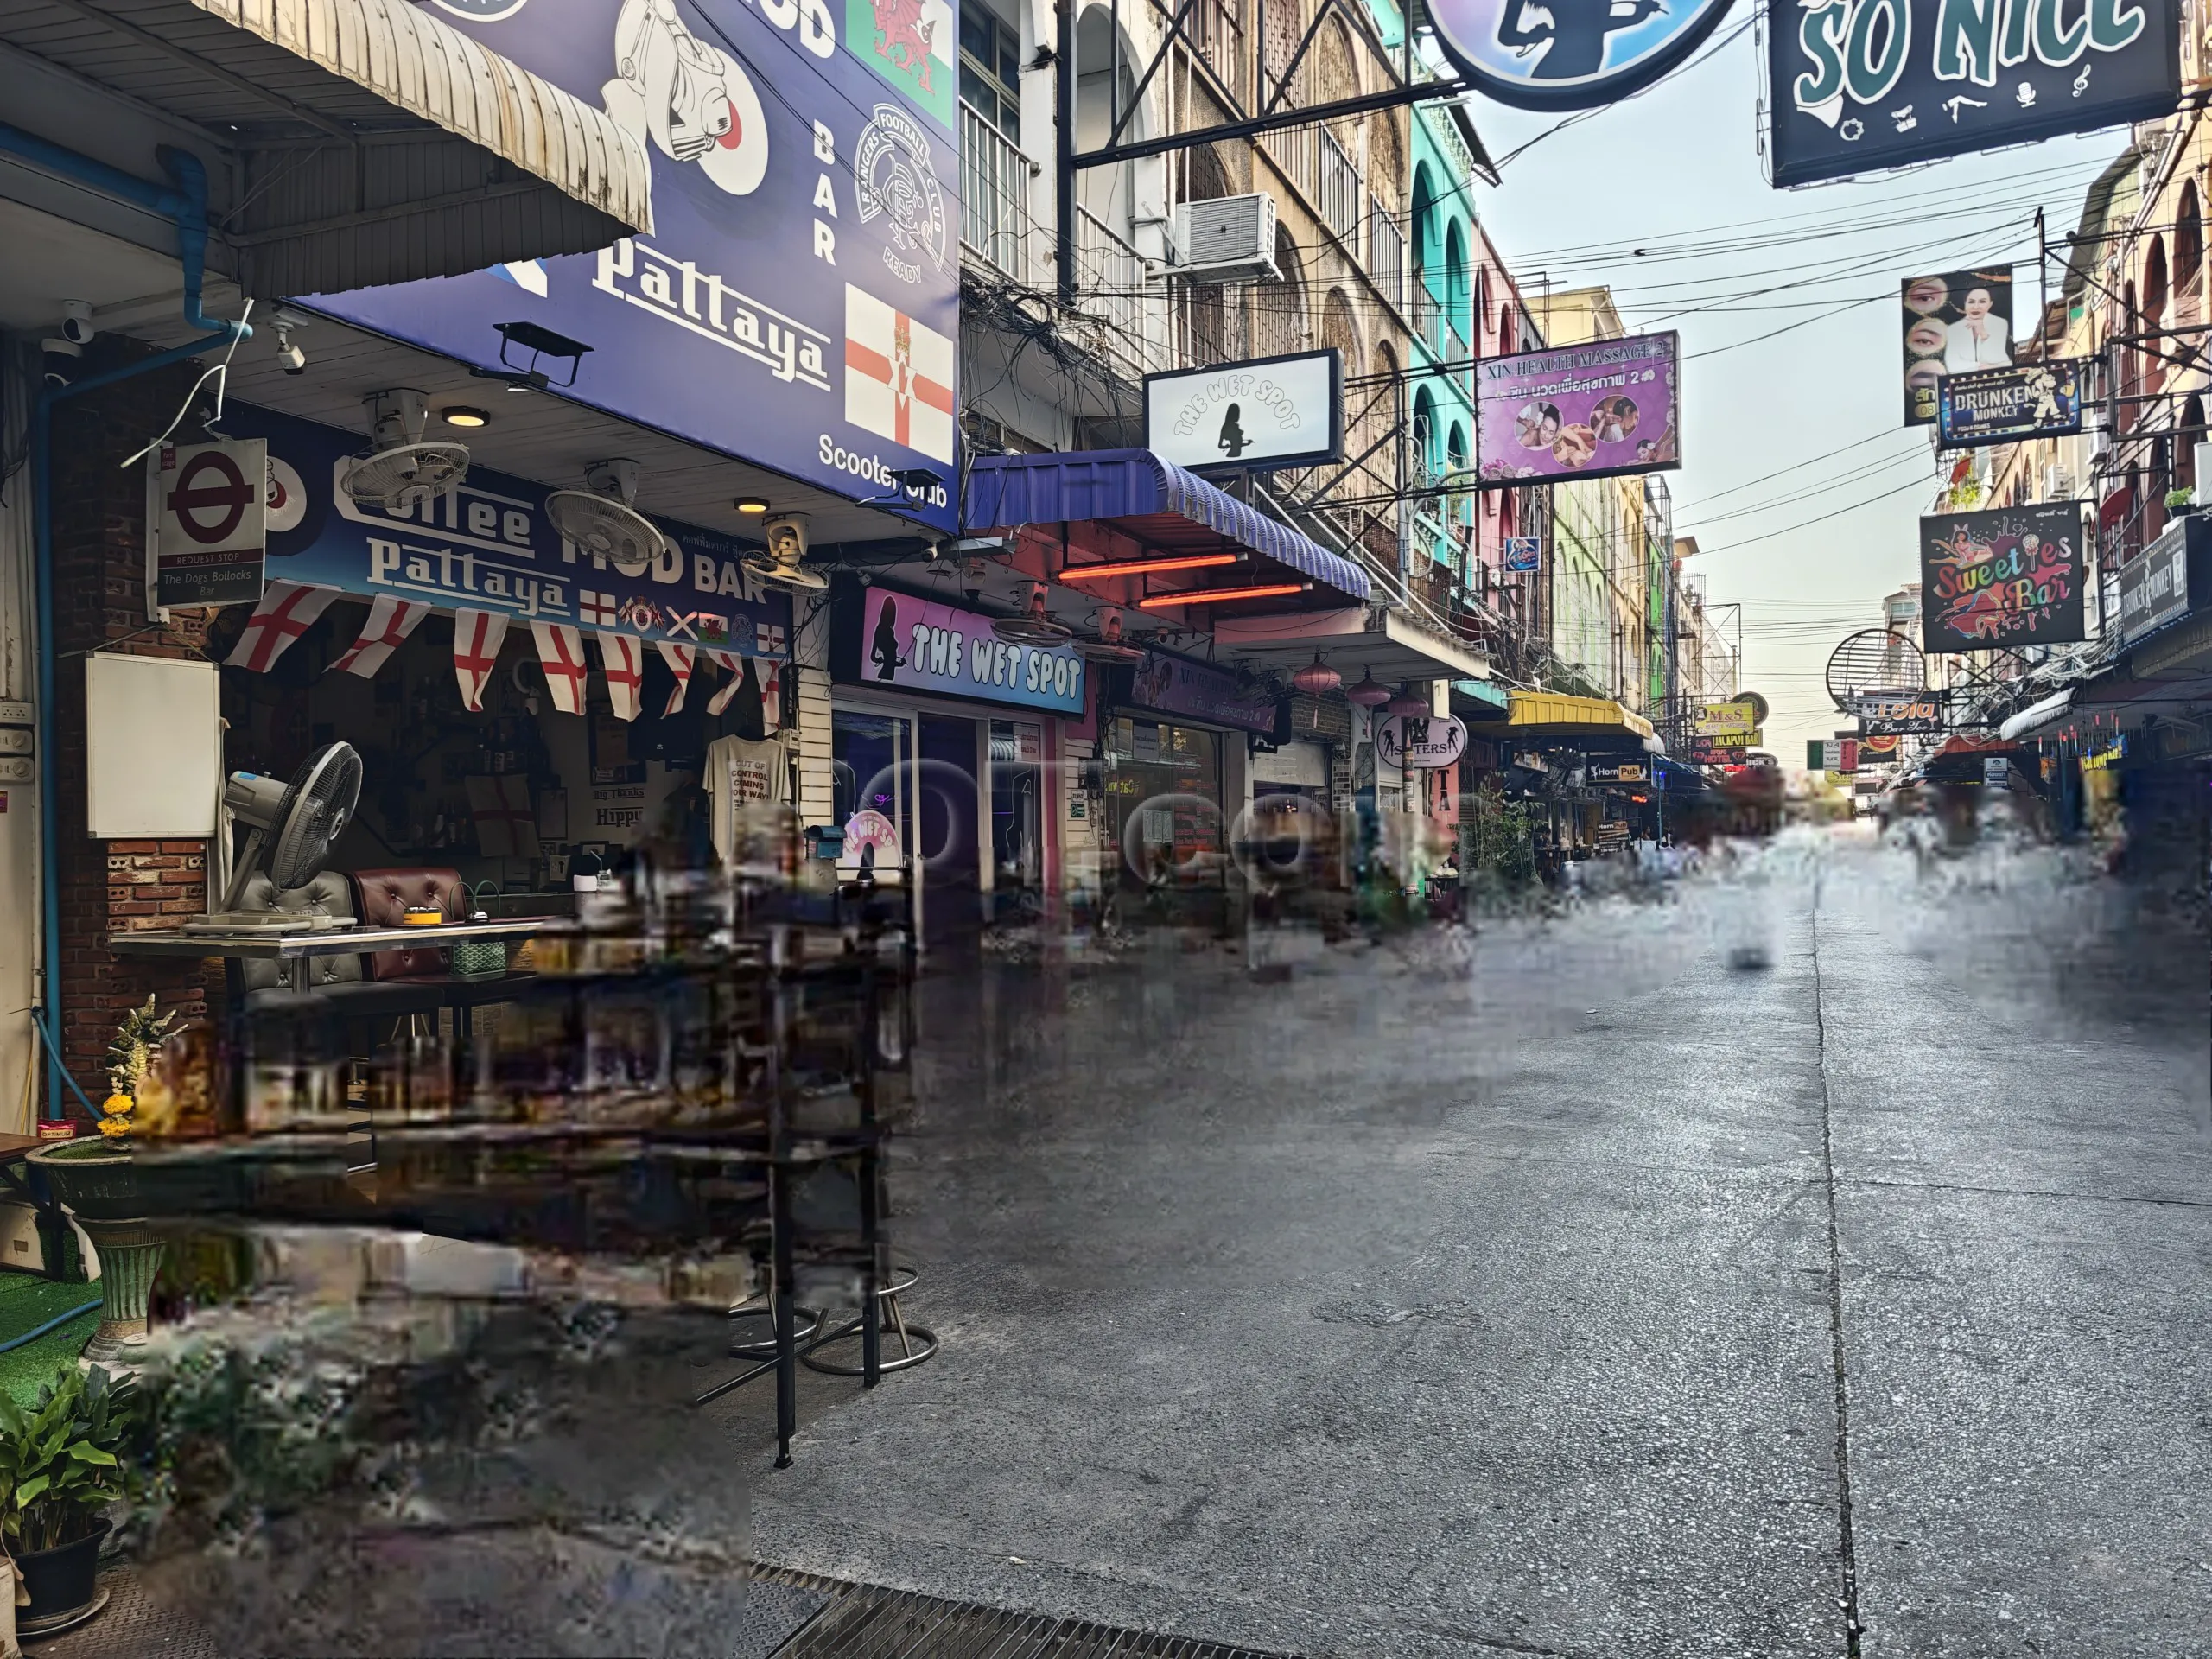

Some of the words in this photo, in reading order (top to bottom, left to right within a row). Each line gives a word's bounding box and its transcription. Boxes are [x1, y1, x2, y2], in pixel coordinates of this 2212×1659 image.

[1793, 0, 1912, 105] SO
[880, 112, 925, 159] FOOTBALL
[860, 130, 881, 207] RANGERS
[813, 118, 837, 266] BAR
[926, 177, 942, 236] CLUB
[882, 245, 922, 284] READY
[592, 237, 831, 391] Pattaya
[1488, 364, 1512, 380] XIN
[1516, 355, 1575, 377] HEALTH
[1579, 343, 1652, 369] MASSAGE
[1630, 372, 1639, 385] 2
[1173, 393, 1208, 435] THE
[1207, 374, 1255, 403] WET
[1255, 379, 1300, 430] SPOT
[1955, 385, 2039, 412] DRUNKEN
[1974, 406, 2019, 422] MONKEY
[818, 434, 897, 491] Scooter
[176, 556, 214, 566] REQUEST
[218, 552, 240, 563] STOP
[1933, 536, 2073, 599] Sweeties
[164, 574, 183, 585] The
[185, 573, 208, 586] Dogs
[212, 569, 251, 583] Bollocks
[200, 586, 215, 597] Bar
[366, 537, 571, 617] Pattaya
[694, 553, 767, 605] BAR
[2004, 575, 2071, 615] Bar
[912, 622, 963, 678] THE
[971, 637, 1023, 690] WET
[1025, 649, 1082, 700] SPOT
[1880, 721, 1905, 734] Bar
[1906, 720, 1929, 732] Too
[735, 760, 753, 768] OUT
[753, 760, 766, 770] OF
[1394, 743, 1448, 756] STERS
[1704, 755, 1732, 764] HOTEL
[731, 768, 768, 783] CONTROL
[734, 779, 765, 791] COMING
[1599, 766, 1619, 776] Horn
[1620, 767, 1639, 776] Pub
[610, 787, 645, 799] Thanks
[858, 820, 881, 837] WET
